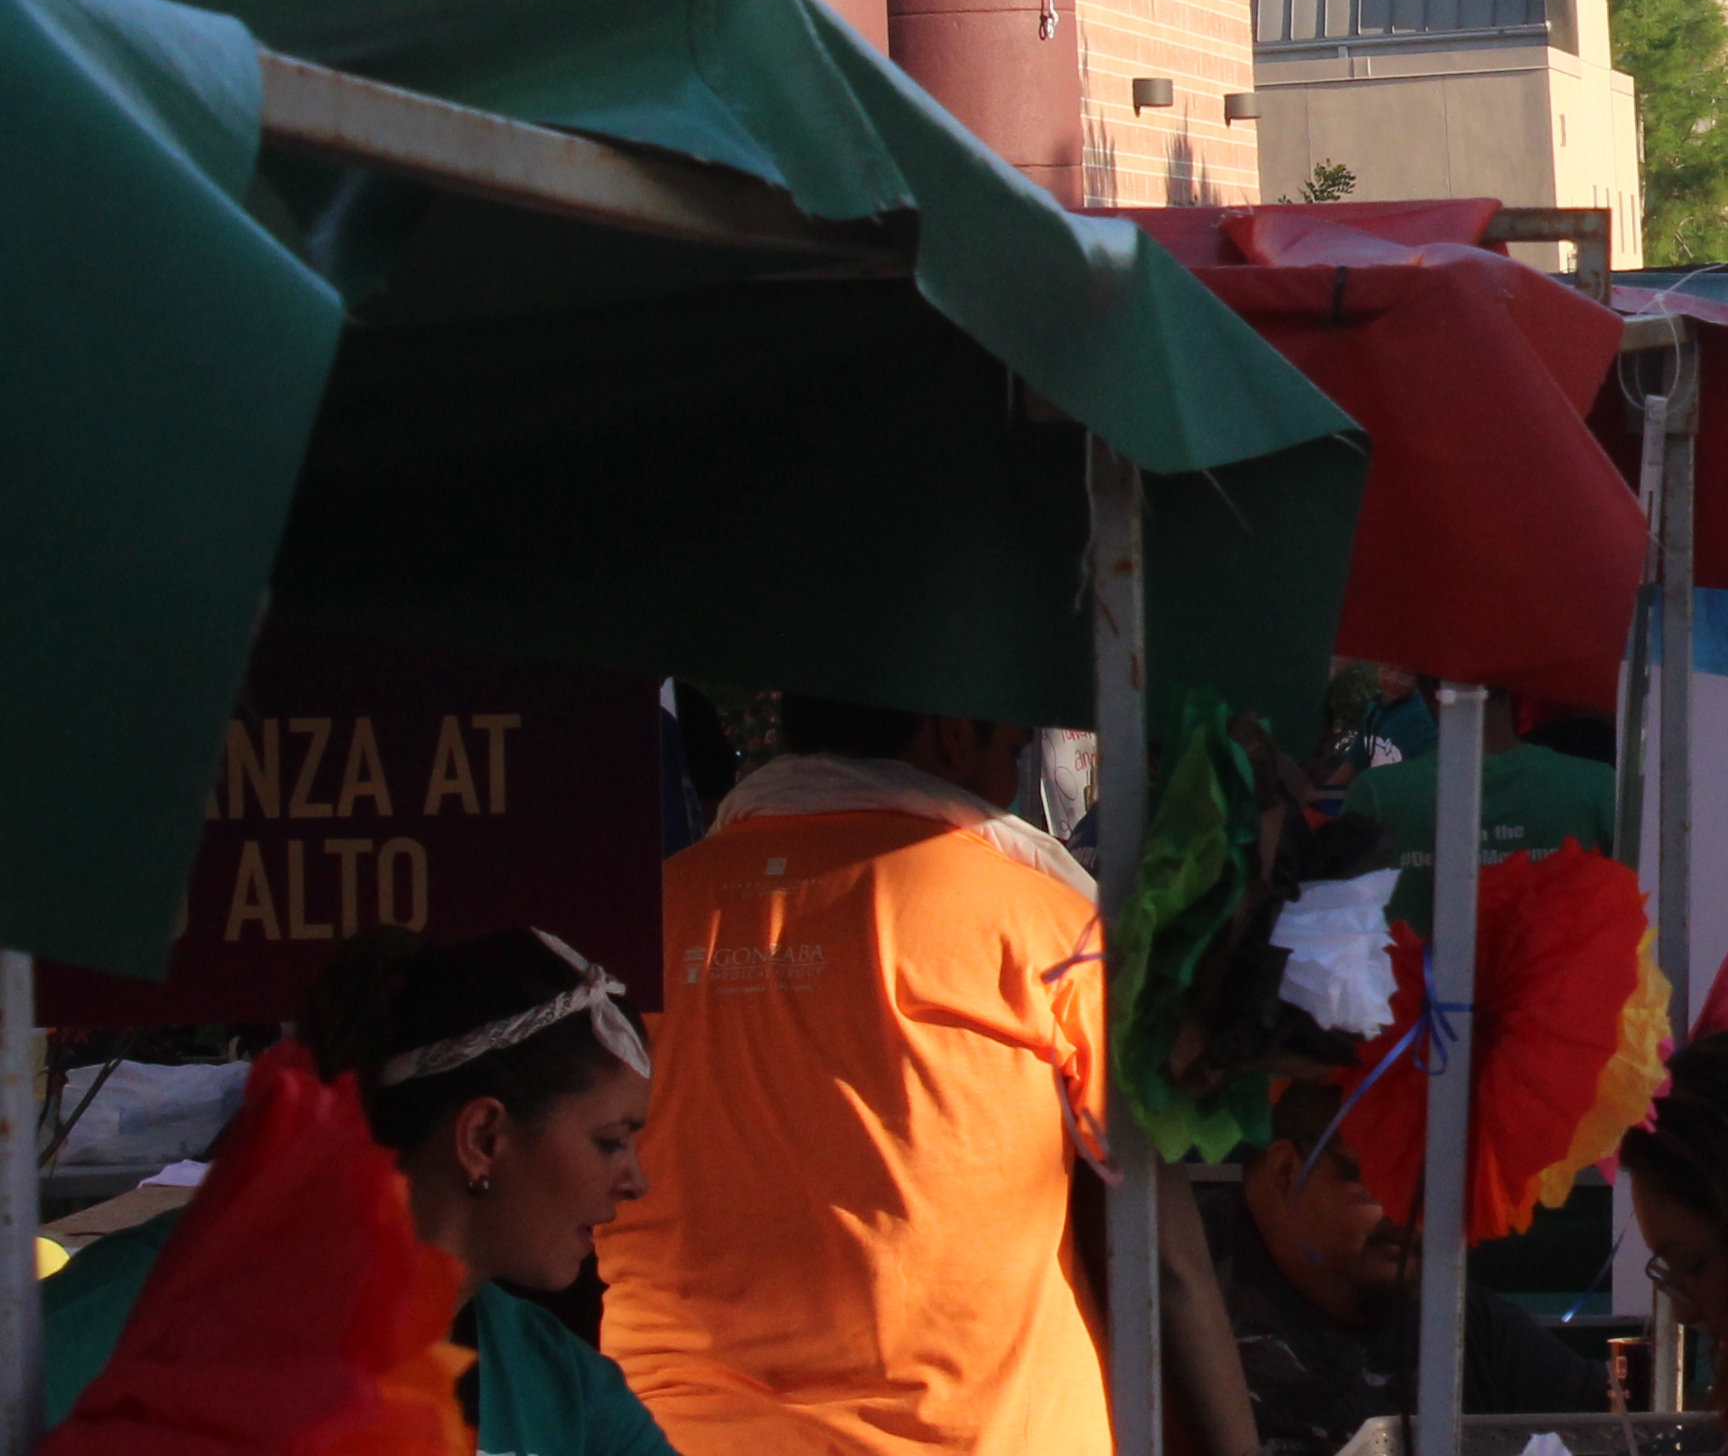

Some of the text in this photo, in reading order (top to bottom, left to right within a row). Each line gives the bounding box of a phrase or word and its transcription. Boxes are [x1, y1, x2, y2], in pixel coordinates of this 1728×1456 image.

[204, 713, 522, 820] NZA AT
[224, 837, 428, 942] ALTO
